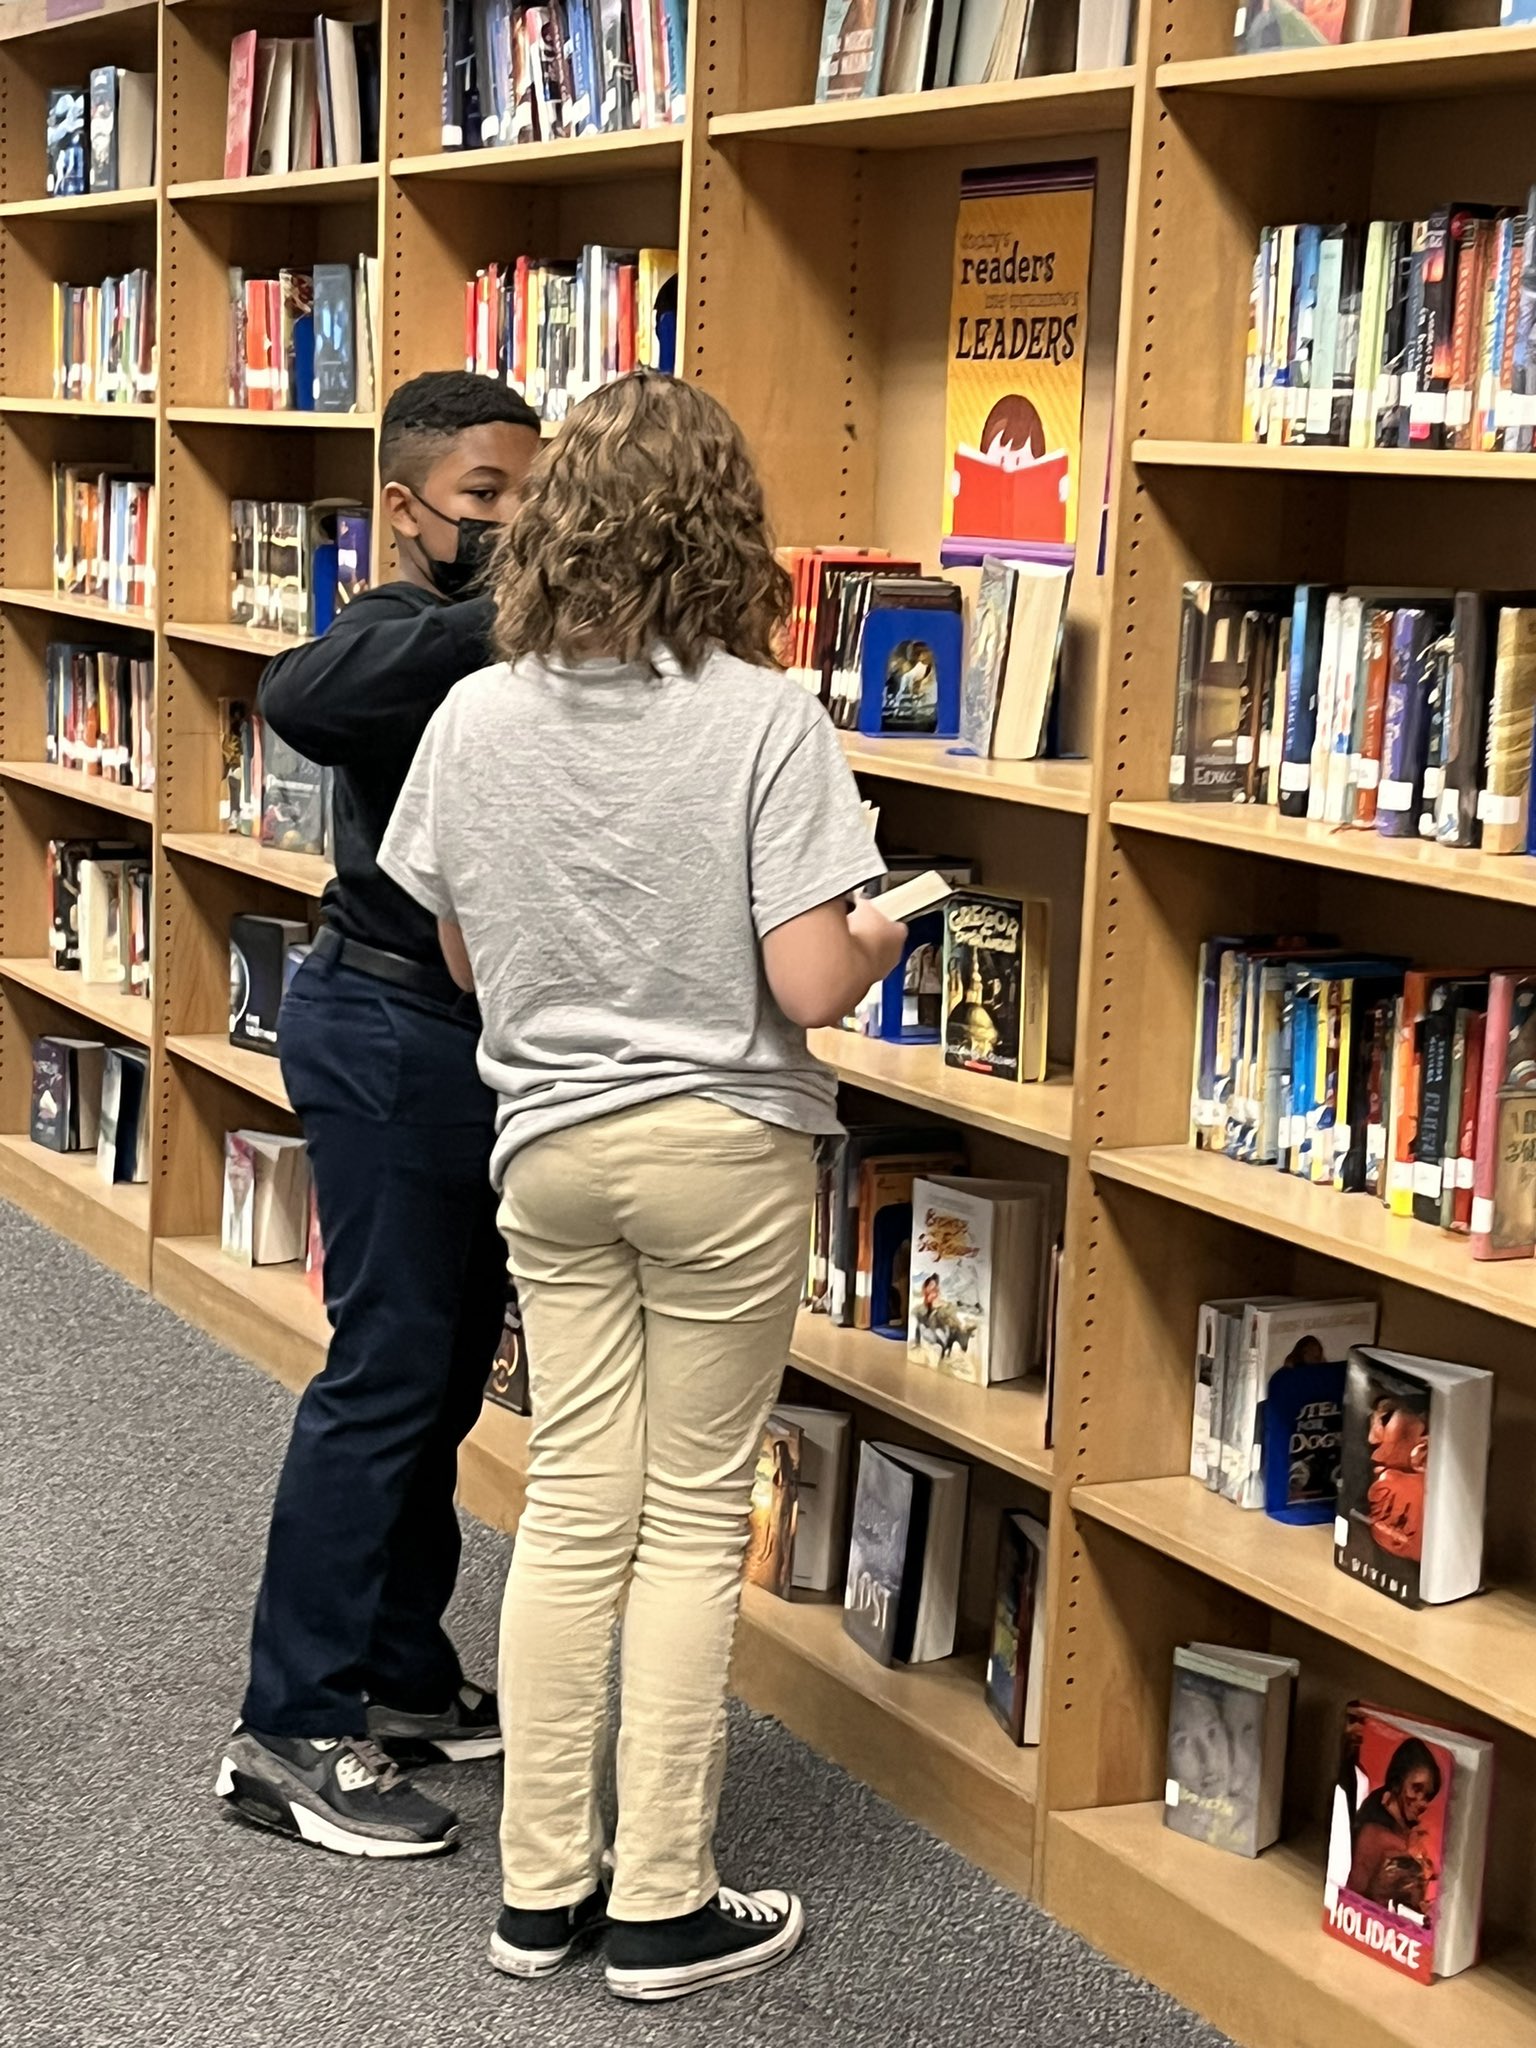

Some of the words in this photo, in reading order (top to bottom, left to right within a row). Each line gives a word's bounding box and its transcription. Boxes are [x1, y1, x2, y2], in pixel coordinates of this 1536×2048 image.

[960, 240, 1056, 285] readers
[955, 313, 1079, 366] LEADERS
[1328, 1901, 1423, 1970] HOLIDAZE
